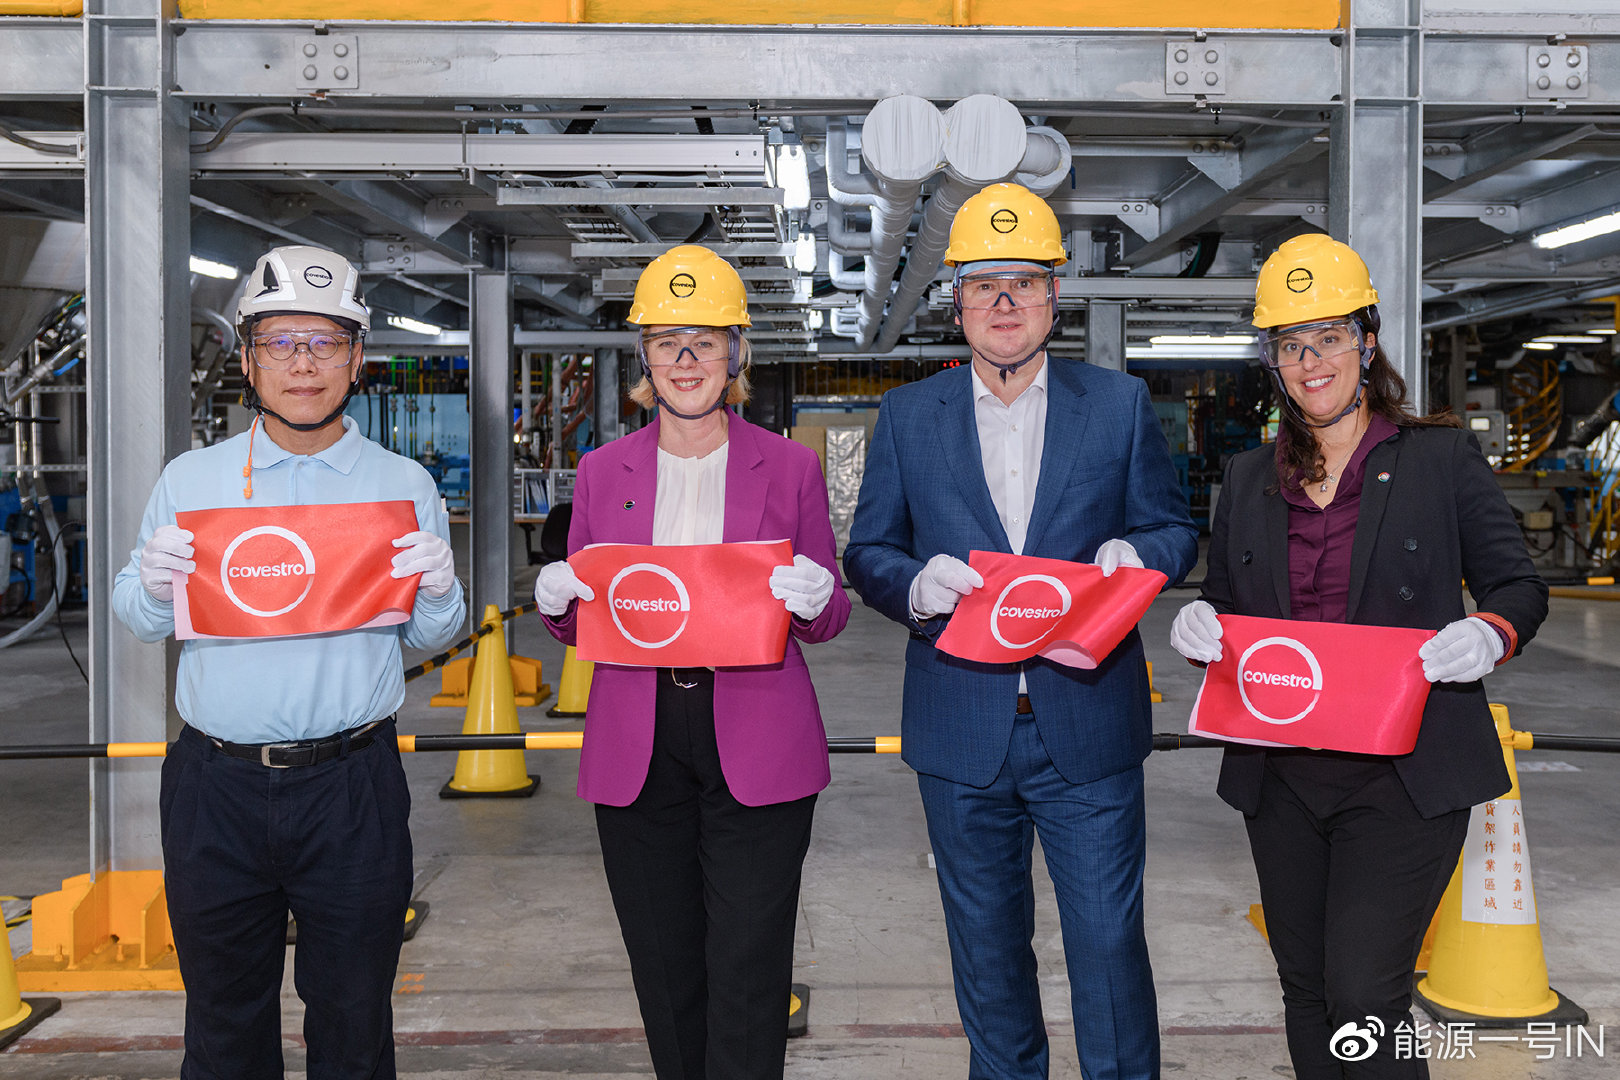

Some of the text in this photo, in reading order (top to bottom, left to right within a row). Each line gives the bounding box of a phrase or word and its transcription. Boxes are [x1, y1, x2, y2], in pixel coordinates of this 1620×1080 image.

[228, 562, 305, 578] covestro
[614, 597, 680, 612] covestro
[1000, 606, 1061, 619] covestro
[1243, 670, 1313, 689] covestro
[1483, 802, 1498, 910] 貨架作業區域
